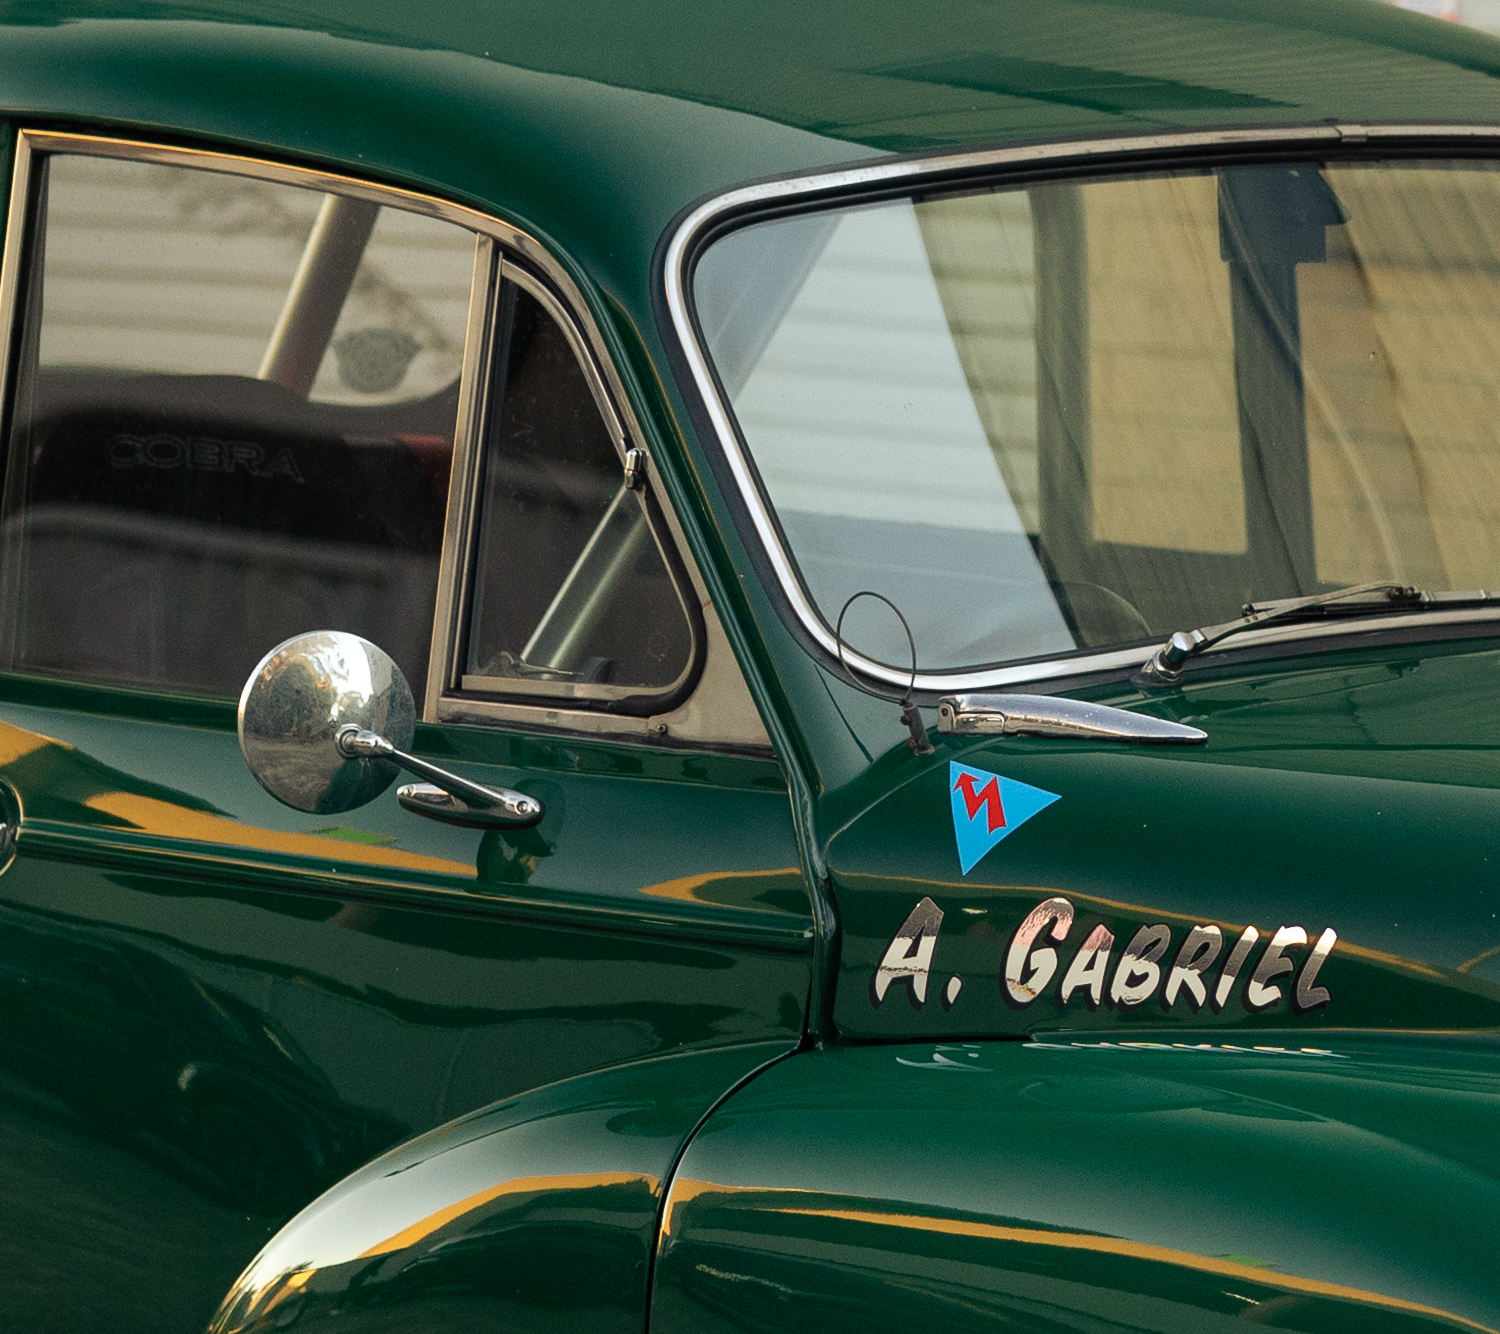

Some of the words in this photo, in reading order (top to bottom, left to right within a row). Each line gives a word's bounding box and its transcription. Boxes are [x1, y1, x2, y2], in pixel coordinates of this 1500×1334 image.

[105, 432, 304, 484] COBRA
[869, 895, 964, 1012] A.
[1000, 896, 1339, 1015] GABRIEL
